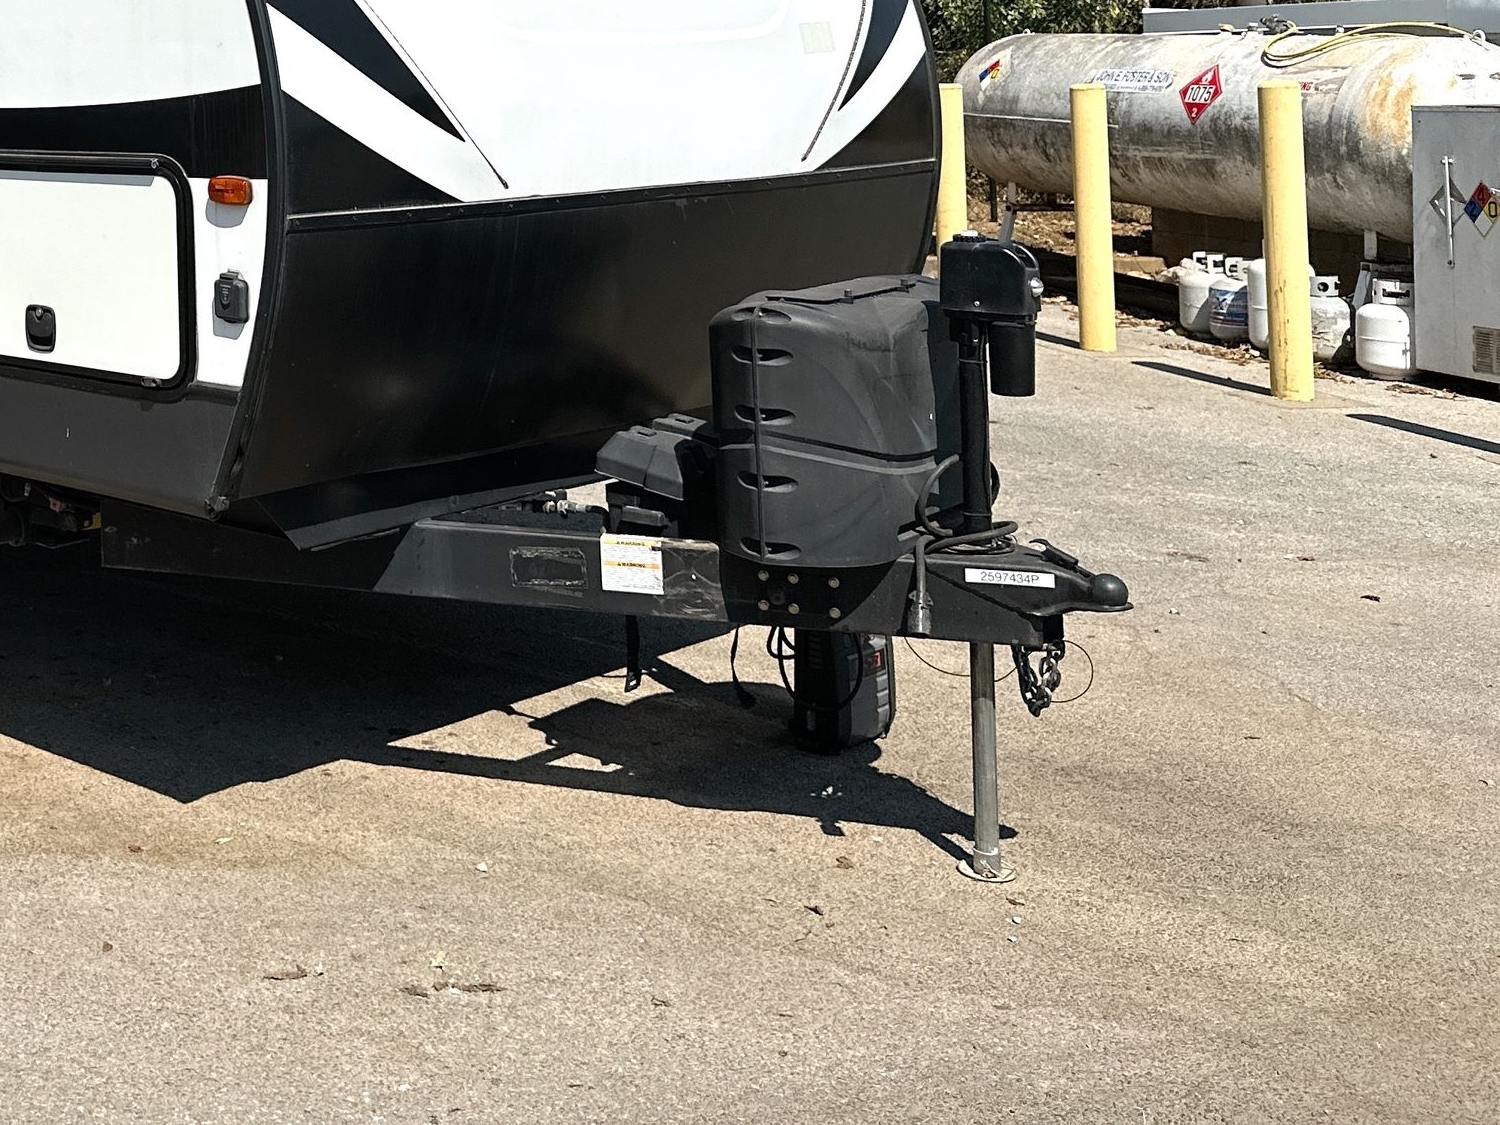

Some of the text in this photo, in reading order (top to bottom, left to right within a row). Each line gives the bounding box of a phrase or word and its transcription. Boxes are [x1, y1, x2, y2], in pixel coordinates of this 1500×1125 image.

[1187, 85, 1214, 102] 1075
[1191, 107, 1198, 117] 2
[1488, 201, 1498, 218] 0
[980, 571, 1040, 584] 2597434P
